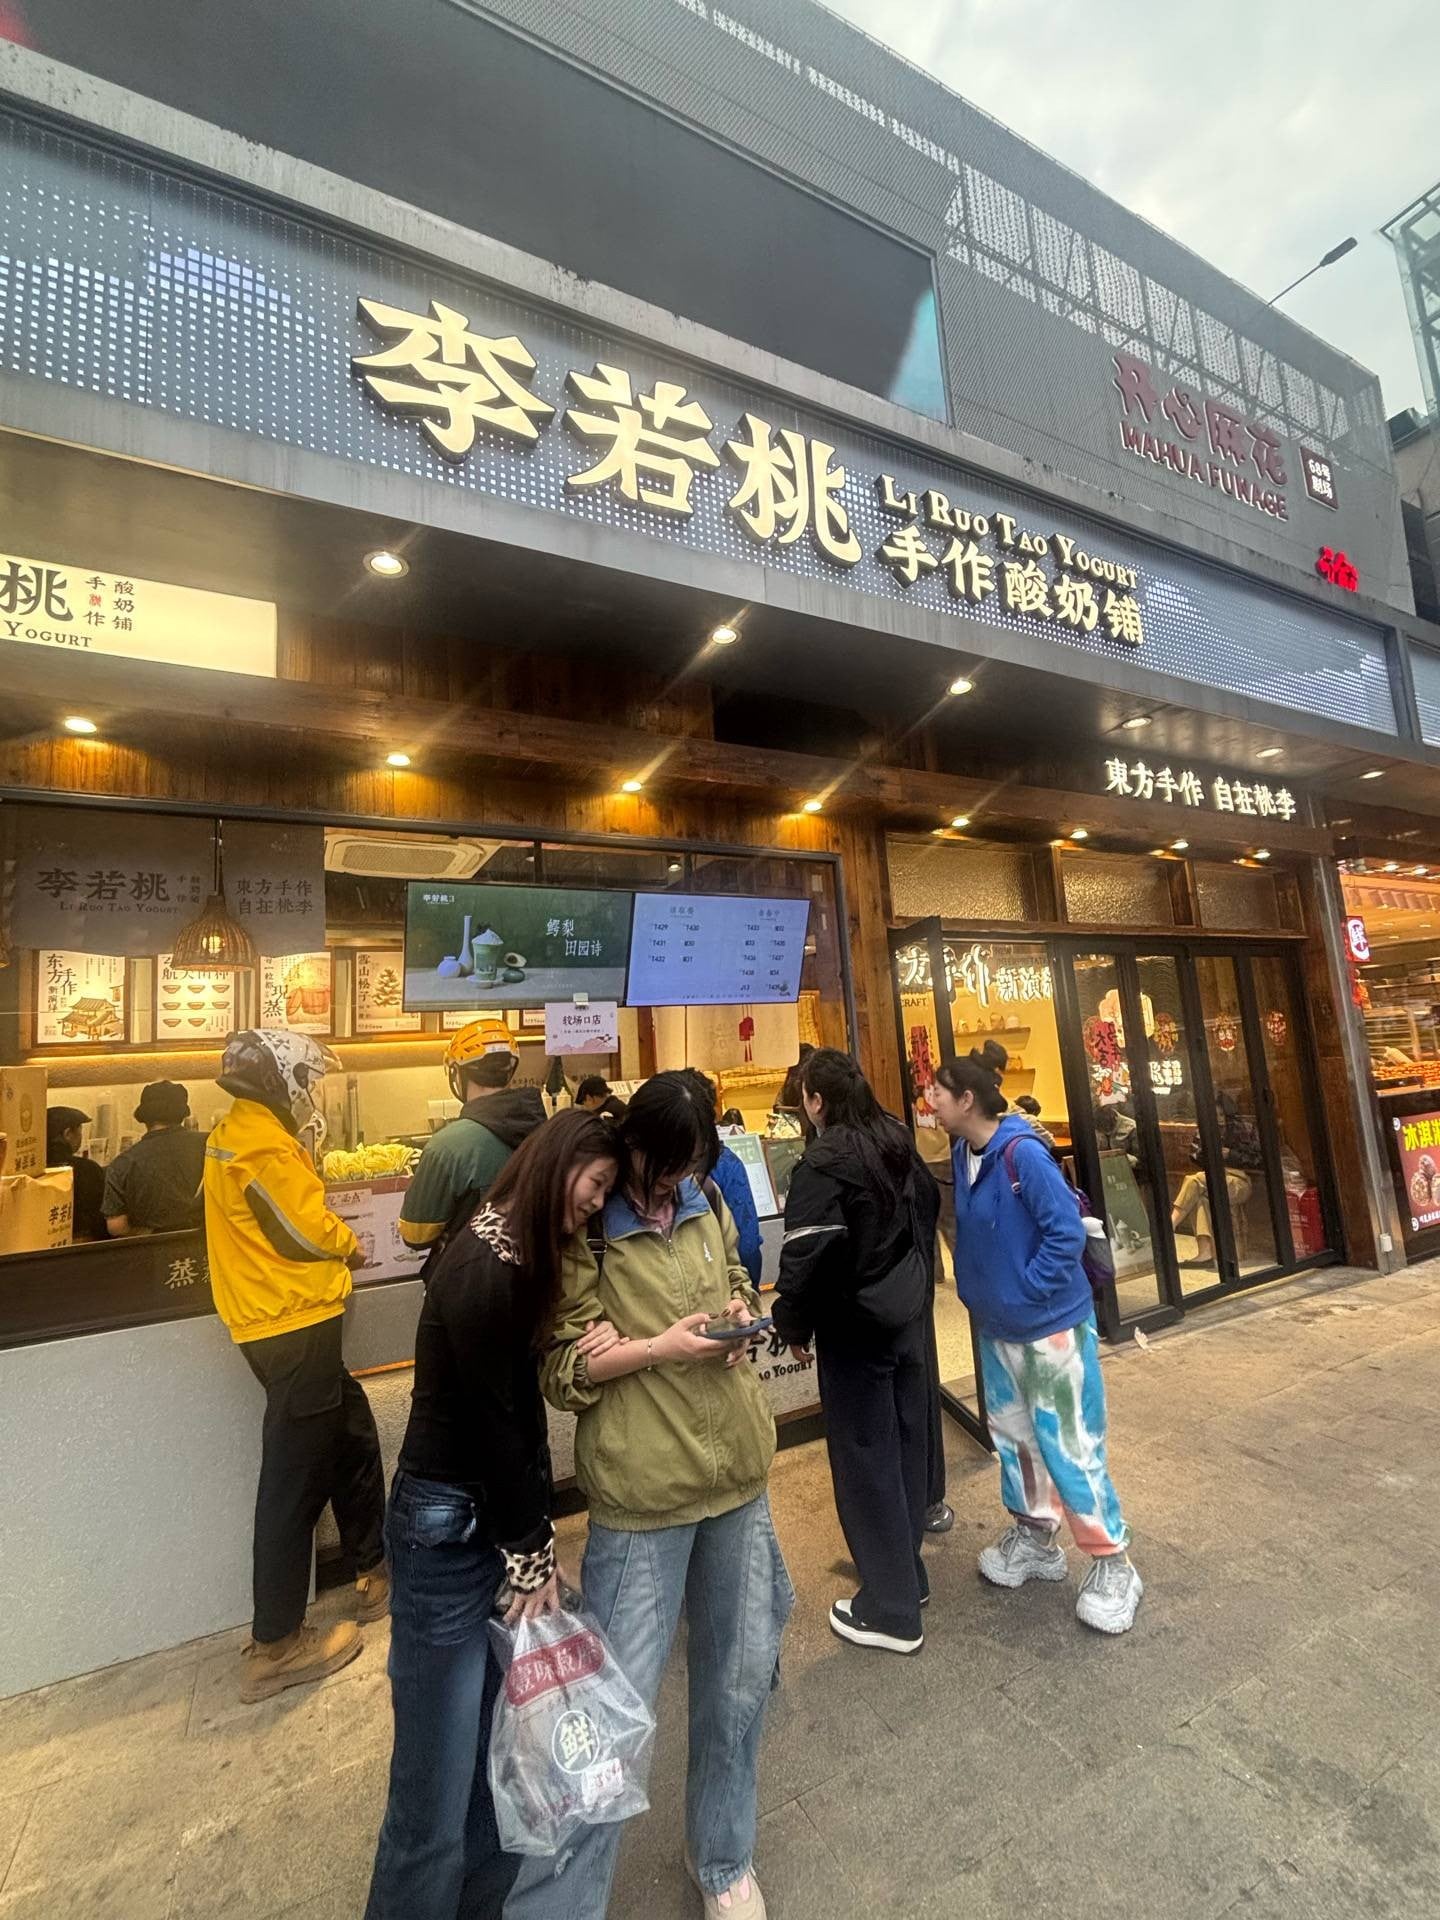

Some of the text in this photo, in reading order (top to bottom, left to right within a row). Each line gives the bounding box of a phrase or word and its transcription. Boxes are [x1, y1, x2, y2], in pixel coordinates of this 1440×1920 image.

[352, 297, 863, 568] 李若桃
[1113, 355, 1288, 487] 开心麻花
[1119, 420, 1289, 522] MAHUA FUNAGE
[926, 489, 989, 536] RUO
[996, 512, 1047, 556] TAO
[1054, 533, 1138, 589] YOGURT
[0, 560, 74, 621] 桃
[112, 581, 135, 631] 酸奶铺
[882, 525, 1144, 644] 手作酸奶铺
[3, 620, 92, 647] YOGURT
[1104, 757, 1204, 806] 東方手作
[36, 868, 170, 902] 李若桃
[236, 878, 313, 898] 東方手作
[47, 953, 64, 984] 东方
[565, 939, 603, 957] 田园诗
[60, 968, 77, 996] 手作
[263, 984, 292, 1018] 现蒸
[773, 1361, 812, 1378] YOGURT
[560, 1714, 593, 1770] 鲜
